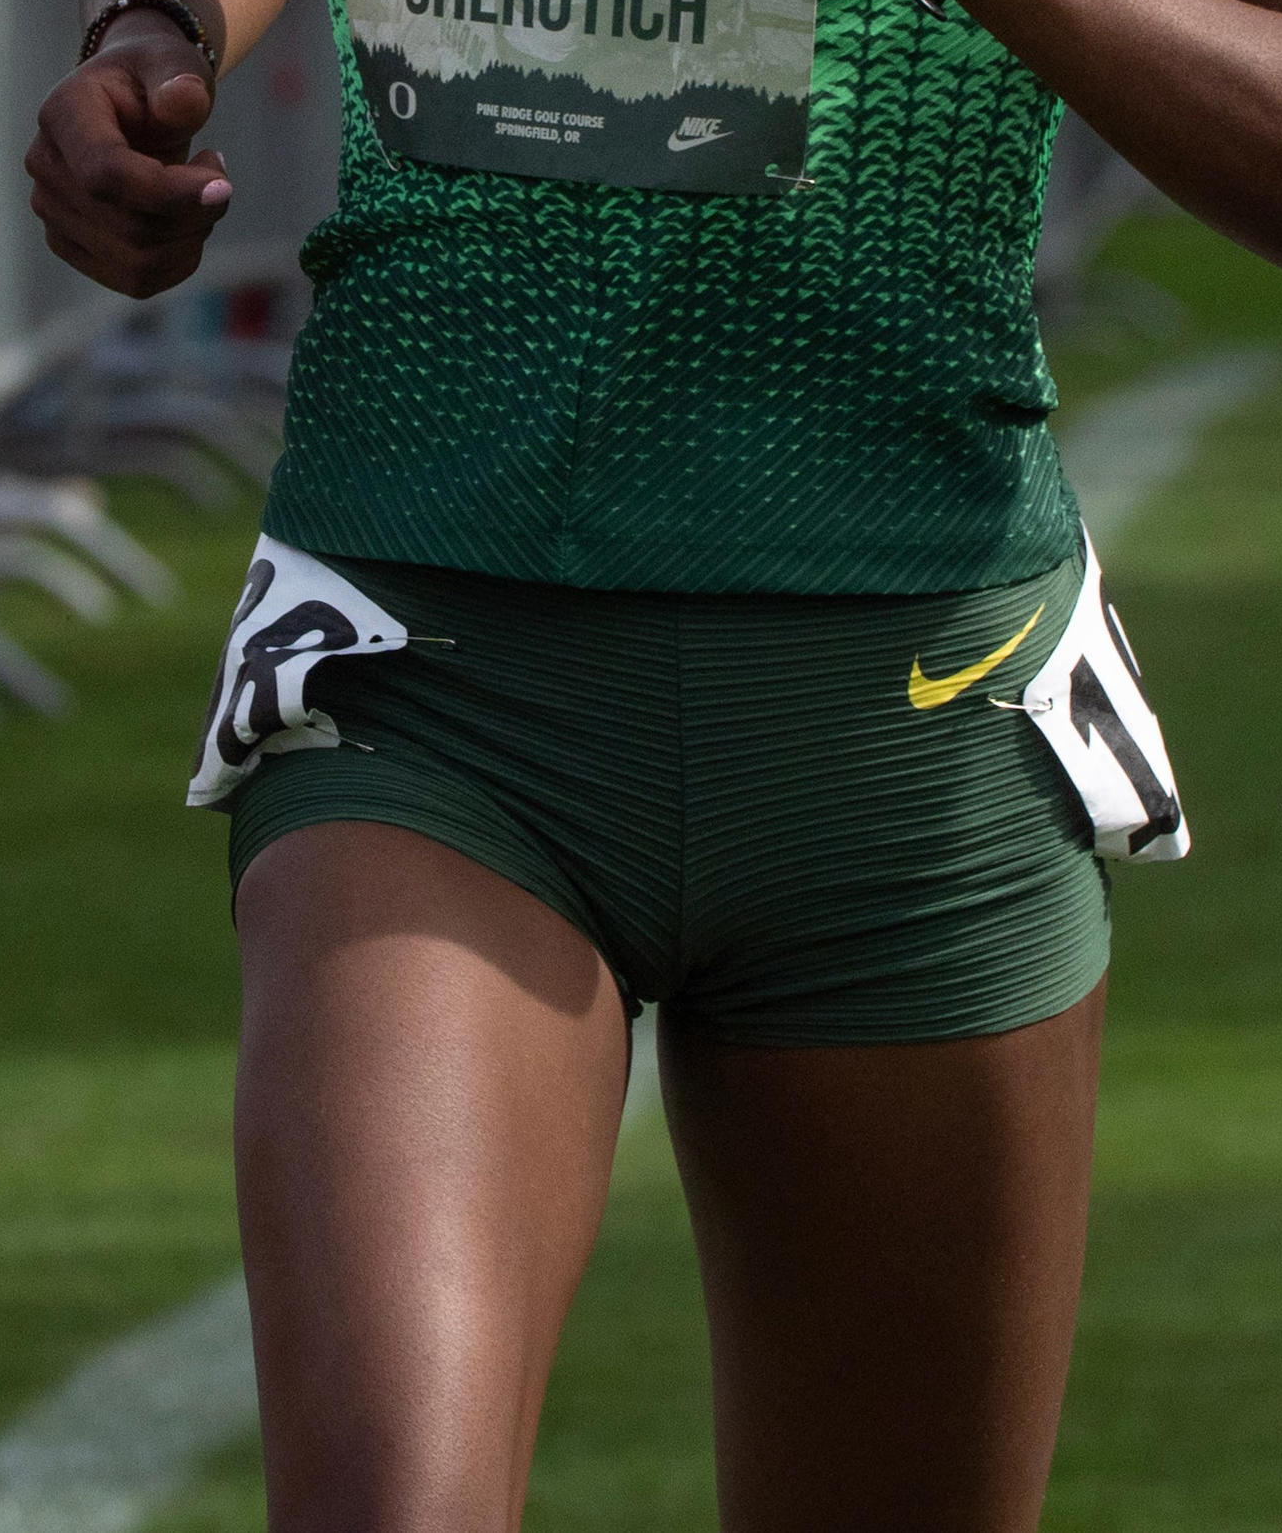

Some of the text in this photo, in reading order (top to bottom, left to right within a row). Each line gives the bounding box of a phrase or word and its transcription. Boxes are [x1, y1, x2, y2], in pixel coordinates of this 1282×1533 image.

[476, 102, 604, 129] PINE RIDGE GOLF COURSE
[495, 122, 580, 144] SPRINGFIELD, OR
[677, 117, 722, 137] NIKE
